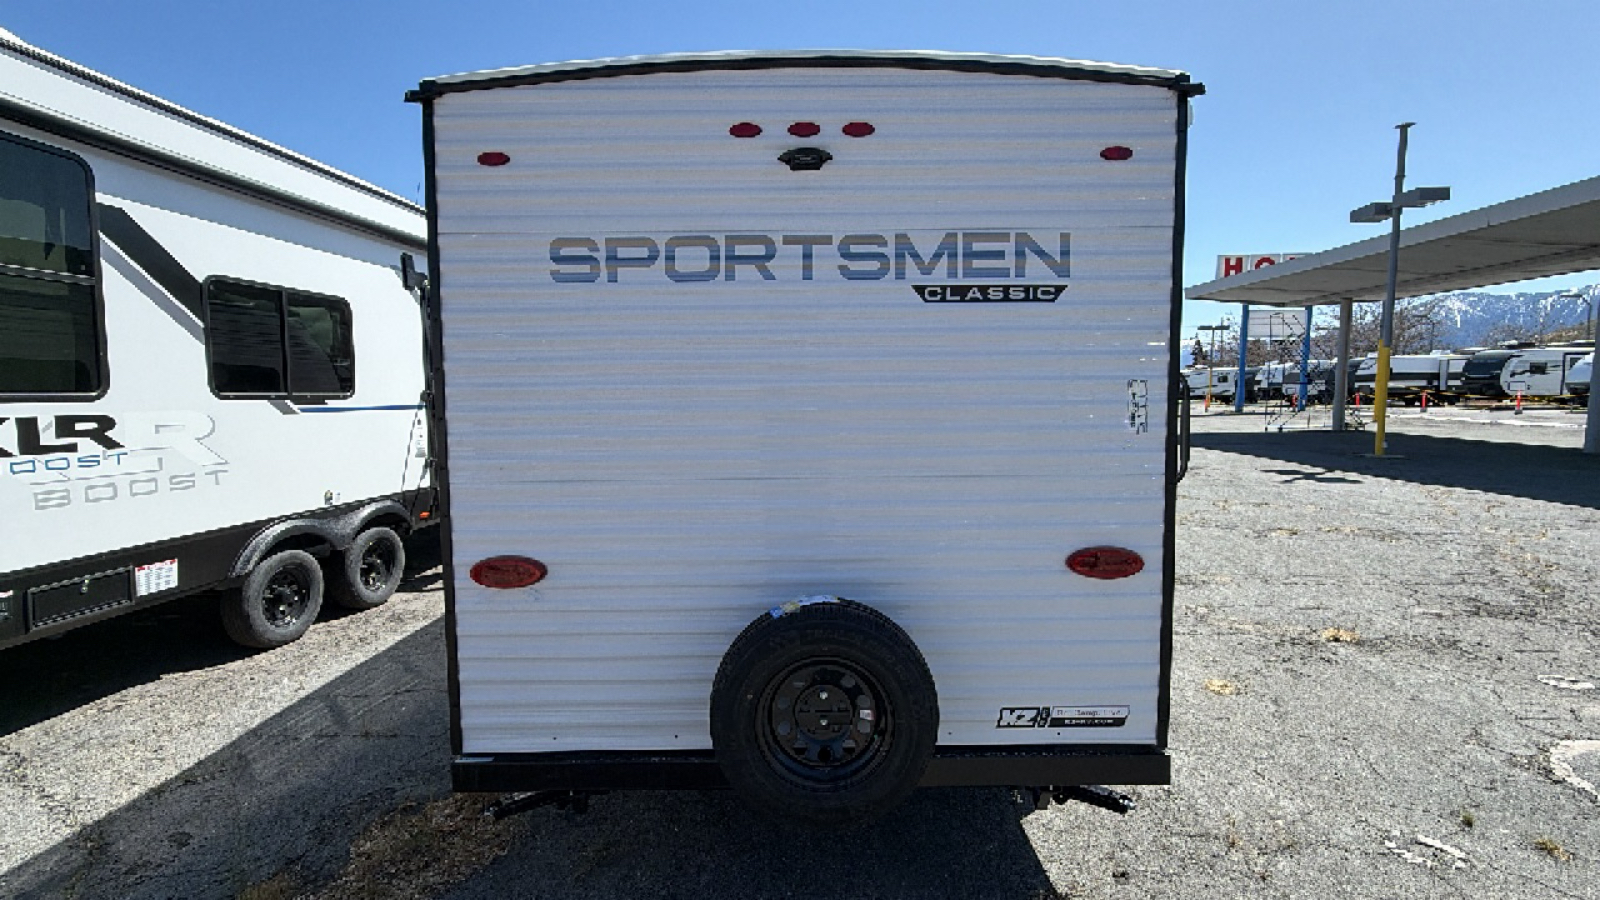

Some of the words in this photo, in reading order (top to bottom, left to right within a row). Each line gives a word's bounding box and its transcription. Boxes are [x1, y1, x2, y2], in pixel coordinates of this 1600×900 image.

[549, 231, 1071, 283] SPORTSMEN
[924, 286, 1056, 301] CLASSIC
[0, 414, 126, 458] LR
[33, 469, 229, 511] BOOST
